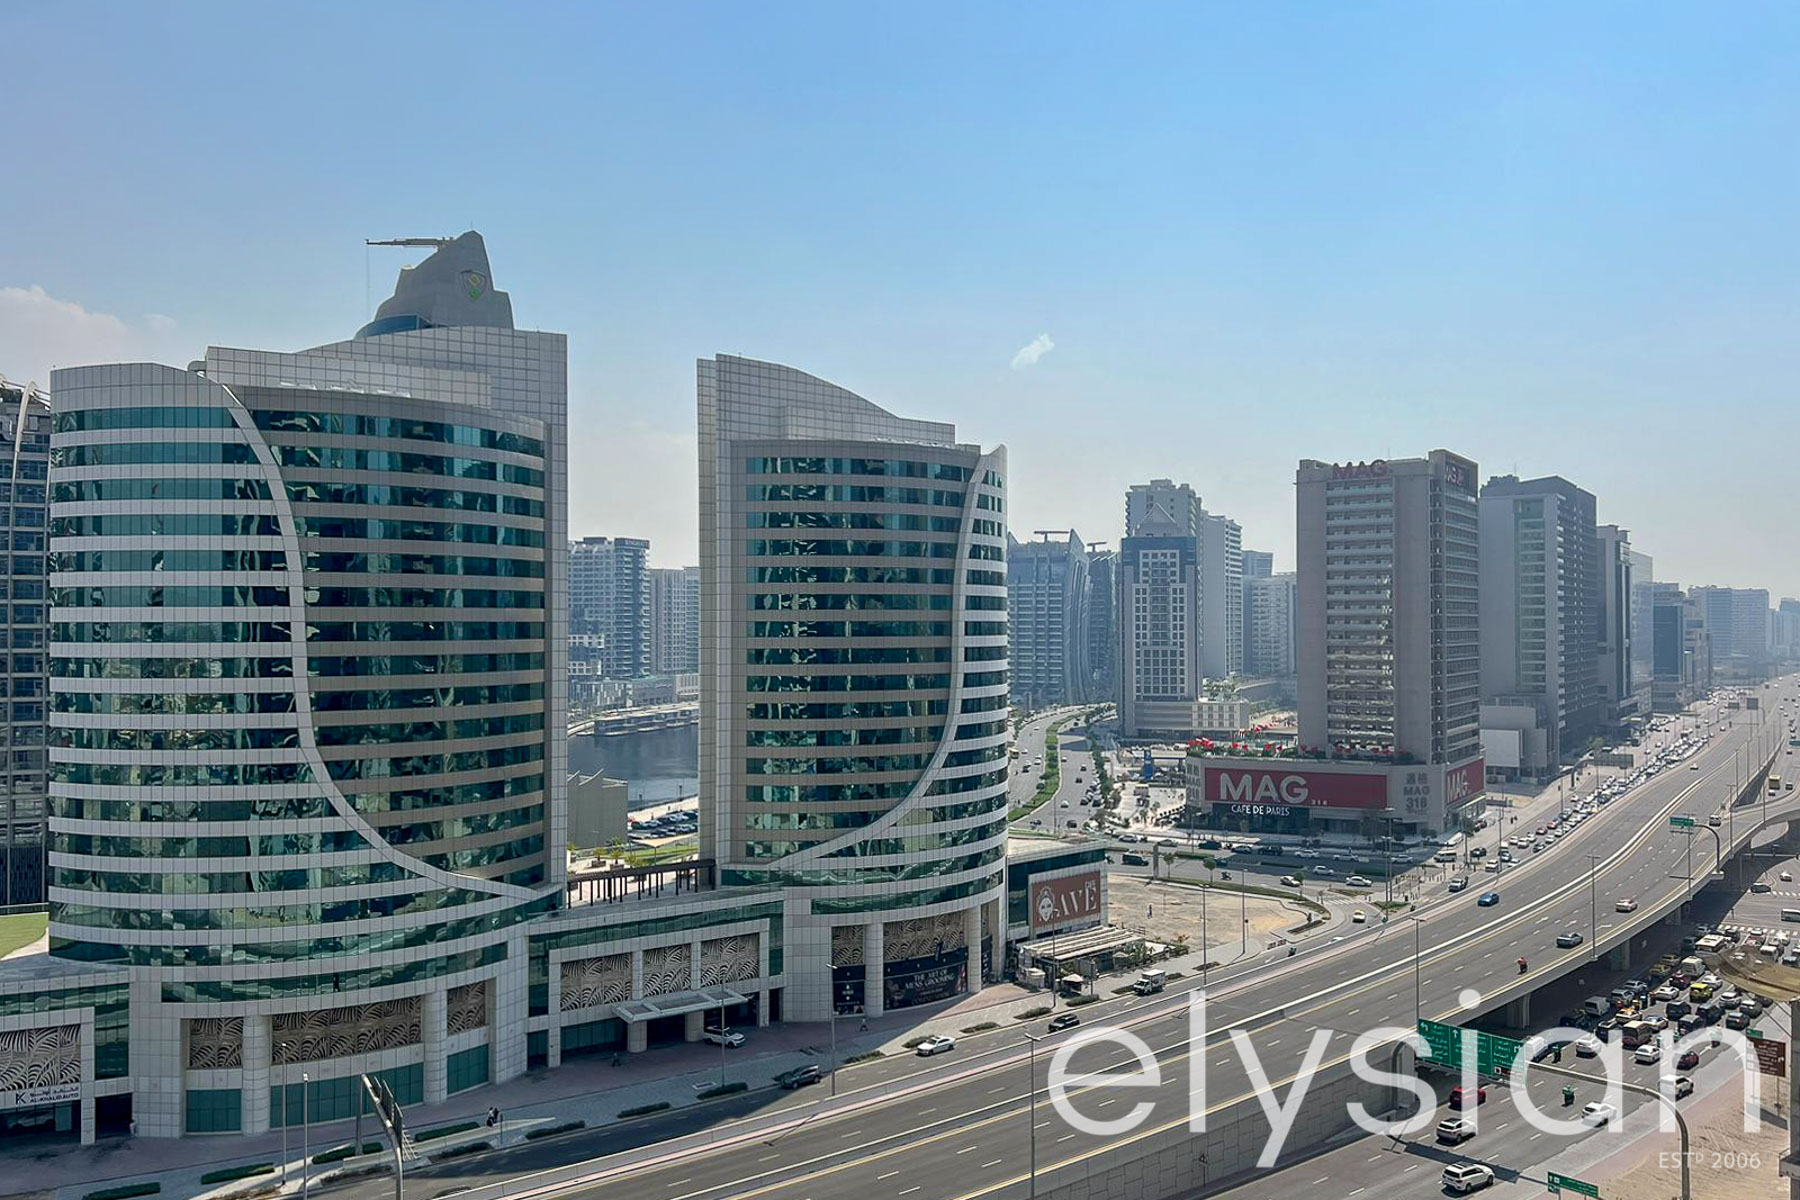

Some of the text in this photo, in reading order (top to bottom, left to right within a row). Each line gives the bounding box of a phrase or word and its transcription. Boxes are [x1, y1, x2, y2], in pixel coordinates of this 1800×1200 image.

[1333, 460, 1388, 479] MAG
[1220, 772, 1309, 804] MAG
[1403, 785, 1430, 796] MAG
[1405, 797, 1428, 809] 318
[1231, 804, 1290, 817] CAFE DE PARIS
